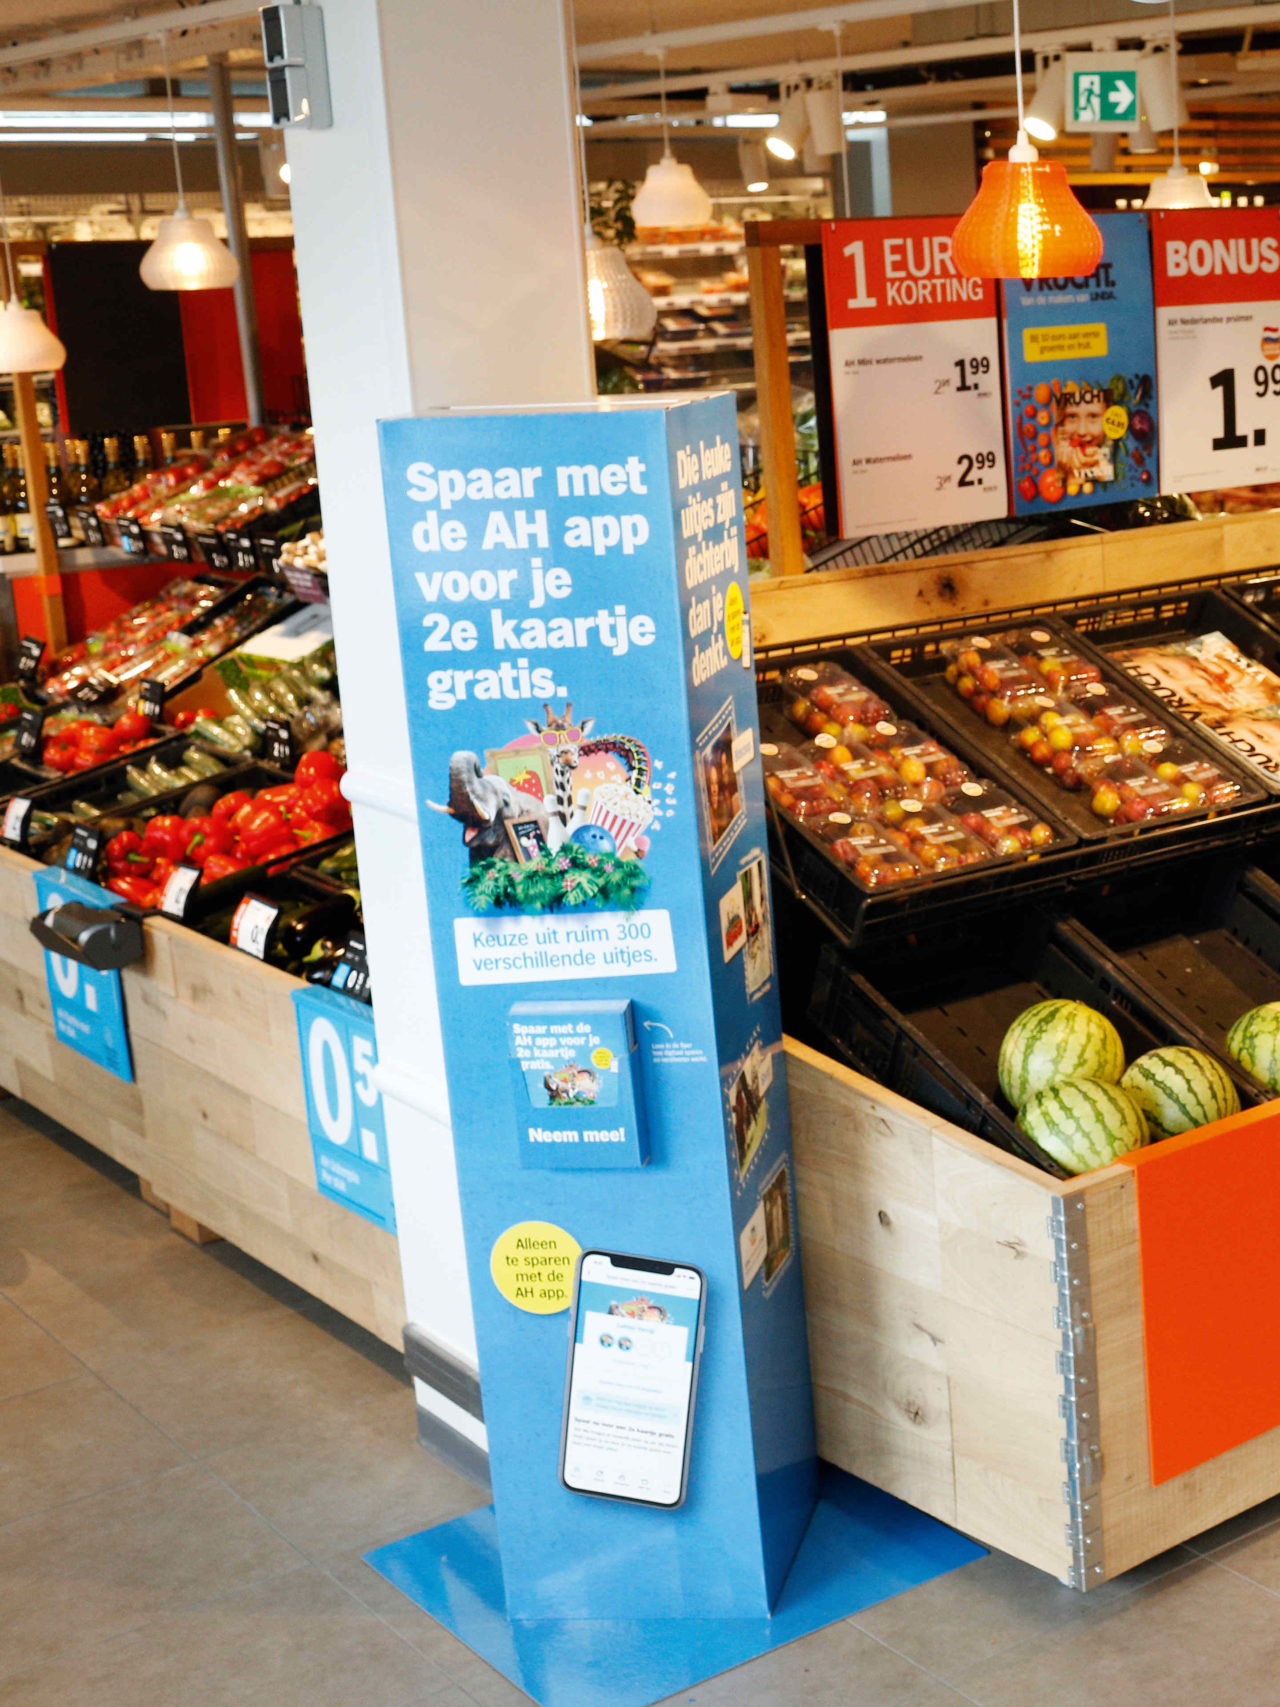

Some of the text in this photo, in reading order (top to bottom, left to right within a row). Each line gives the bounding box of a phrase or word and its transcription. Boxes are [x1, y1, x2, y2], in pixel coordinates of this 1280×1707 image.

[843, 235, 957, 309] 1 EUR
[1166, 237, 1280, 277] BONUS
[886, 277, 984, 307] KORTING
[954, 356, 990, 392] 1.99
[676, 435, 732, 488] Die leuke
[957, 451, 996, 488] 2.99
[406, 456, 648, 509] Spaar met
[681, 481, 736, 542] uitjes zijn
[412, 509, 649, 555] de AH app
[685, 526, 739, 590] dichterbij
[415, 557, 572, 608] voor je
[422, 605, 656, 655] 2e kaartje
[688, 597, 711, 639] dan
[711, 585, 723, 634] je
[692, 633, 728, 687] denkt.
[427, 658, 568, 710] gratis.
[472, 922, 651, 948] Keuze uit ruim 300
[472, 948, 658, 972] verschillende uitjes.
[512, 1022, 592, 1036] Spaar met de
[515, 1034, 600, 1048] AH app voor je
[516, 1046, 576, 1060] 2e kaartje
[521, 1059, 555, 1072] gratis.
[528, 1127, 626, 1143] Neem mee!
[506, 1255, 570, 1268] te sparen
[516, 1237, 557, 1250] Alleen
[515, 1287, 568, 1301] AH app.
[516, 1270, 564, 1283] met de
